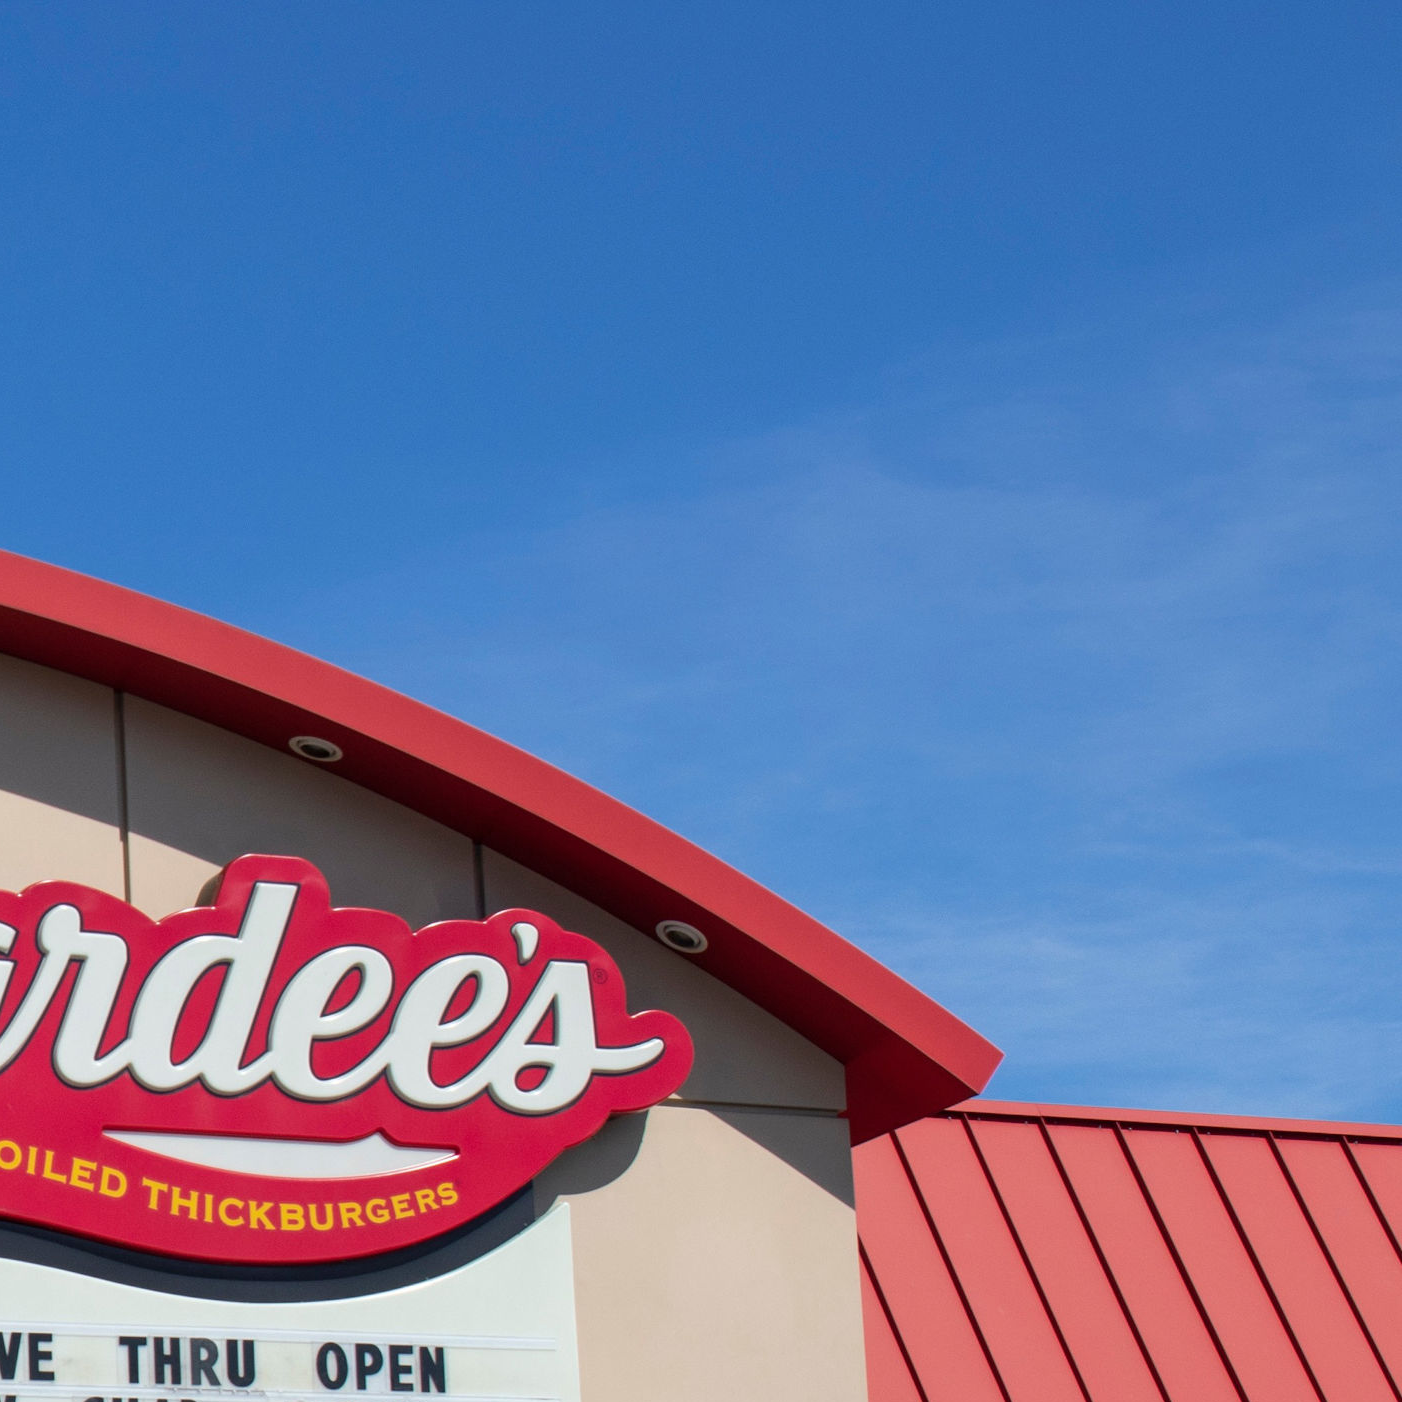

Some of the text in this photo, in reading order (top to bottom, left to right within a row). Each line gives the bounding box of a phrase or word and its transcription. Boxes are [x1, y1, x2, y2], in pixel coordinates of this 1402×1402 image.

[142, 1176, 459, 1232] THICKBURGERS
[118, 1335, 257, 1388] THRU
[316, 1341, 447, 1393] OPEN
